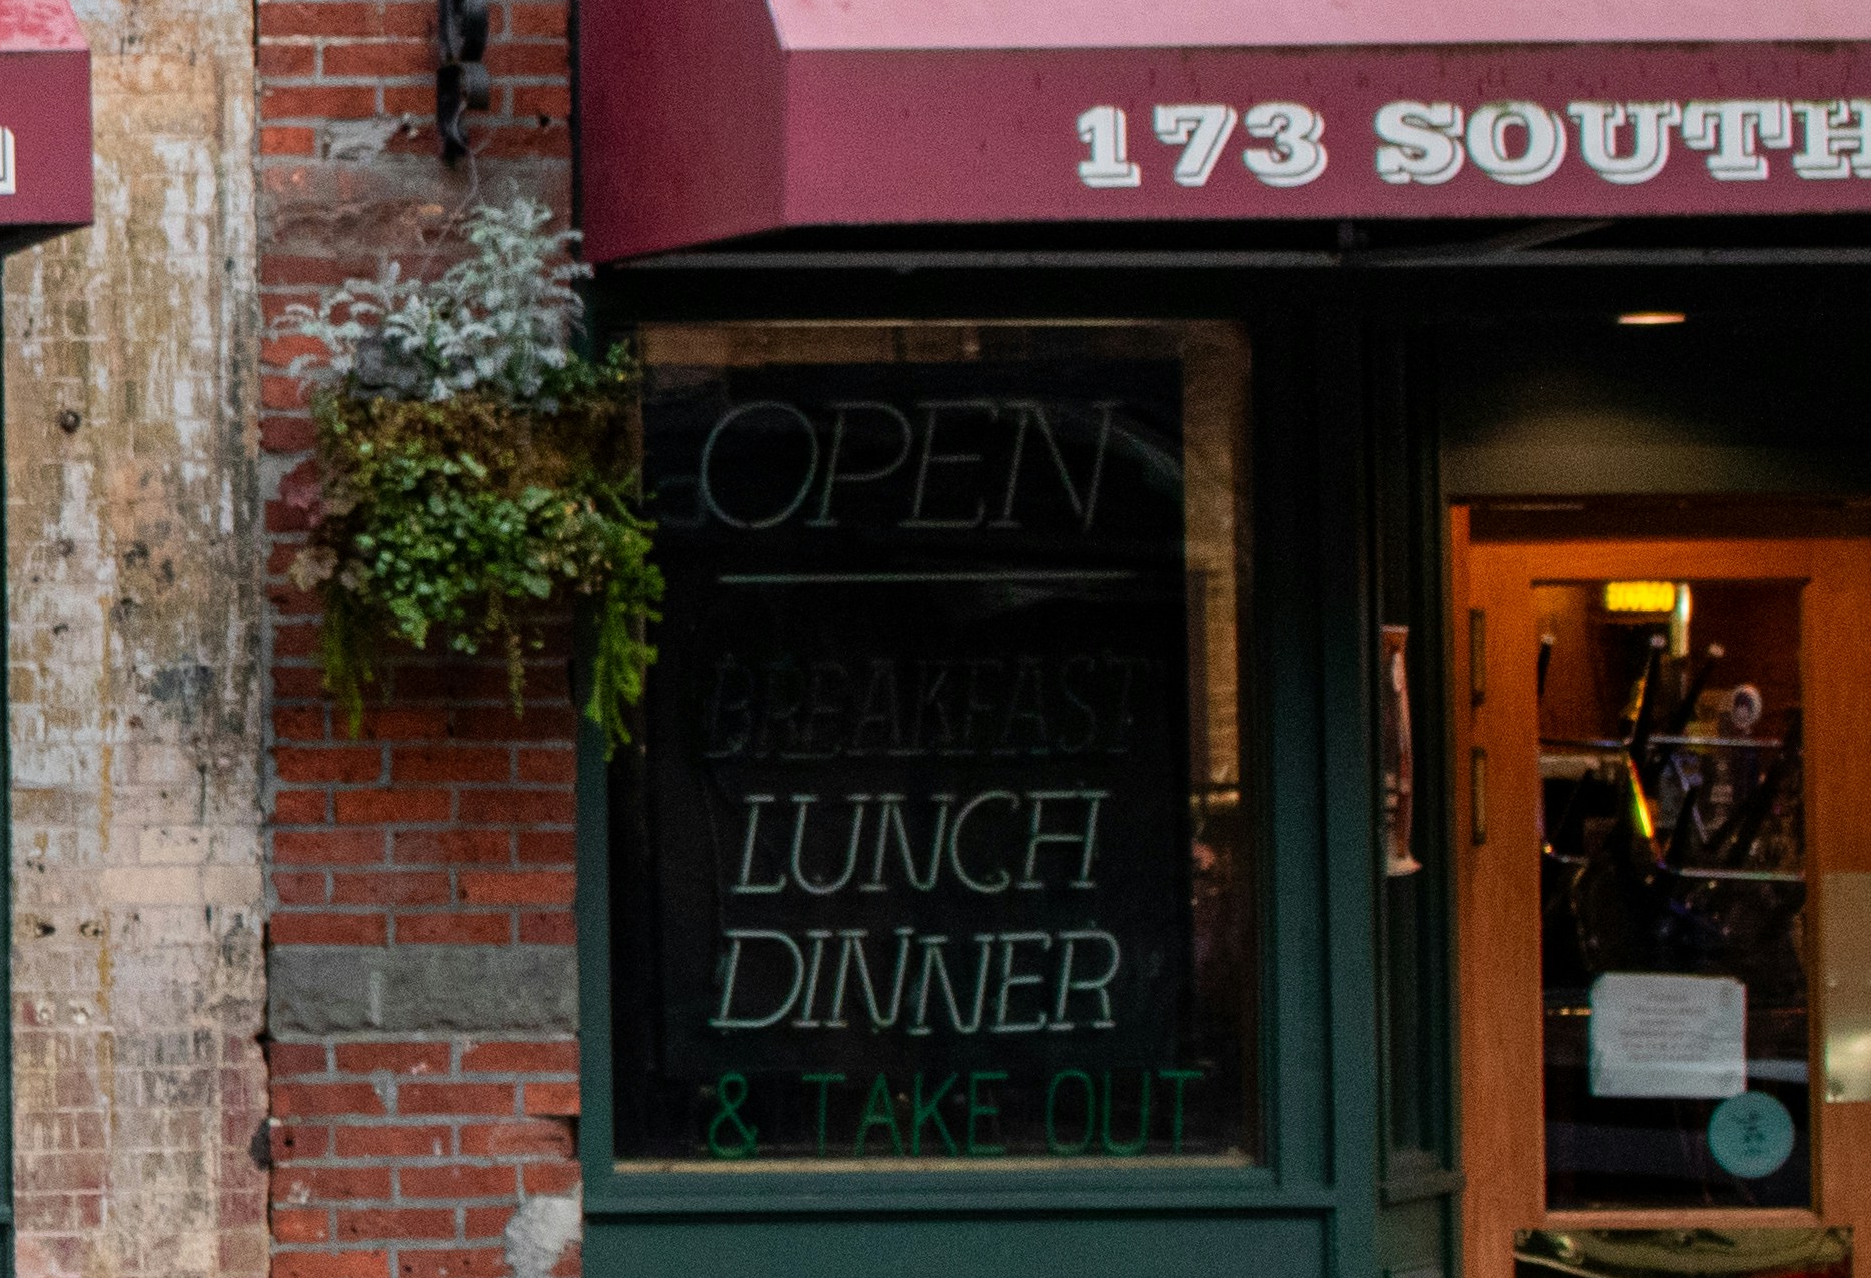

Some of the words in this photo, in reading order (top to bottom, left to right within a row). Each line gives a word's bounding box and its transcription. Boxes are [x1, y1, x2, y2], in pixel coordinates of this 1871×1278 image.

[1076, 101, 1328, 188] 173
[1374, 98, 1871, 185] SOUTH
[700, 400, 1125, 529] OPEN
[704, 654, 1143, 759] BREAKFAST
[731, 789, 1110, 894] LUNCH
[709, 924, 1124, 1035] DINNER
[707, 1072, 759, 1159] &
[802, 1071, 1009, 1158] TAKE
[1044, 1068, 1205, 1158] OUT
